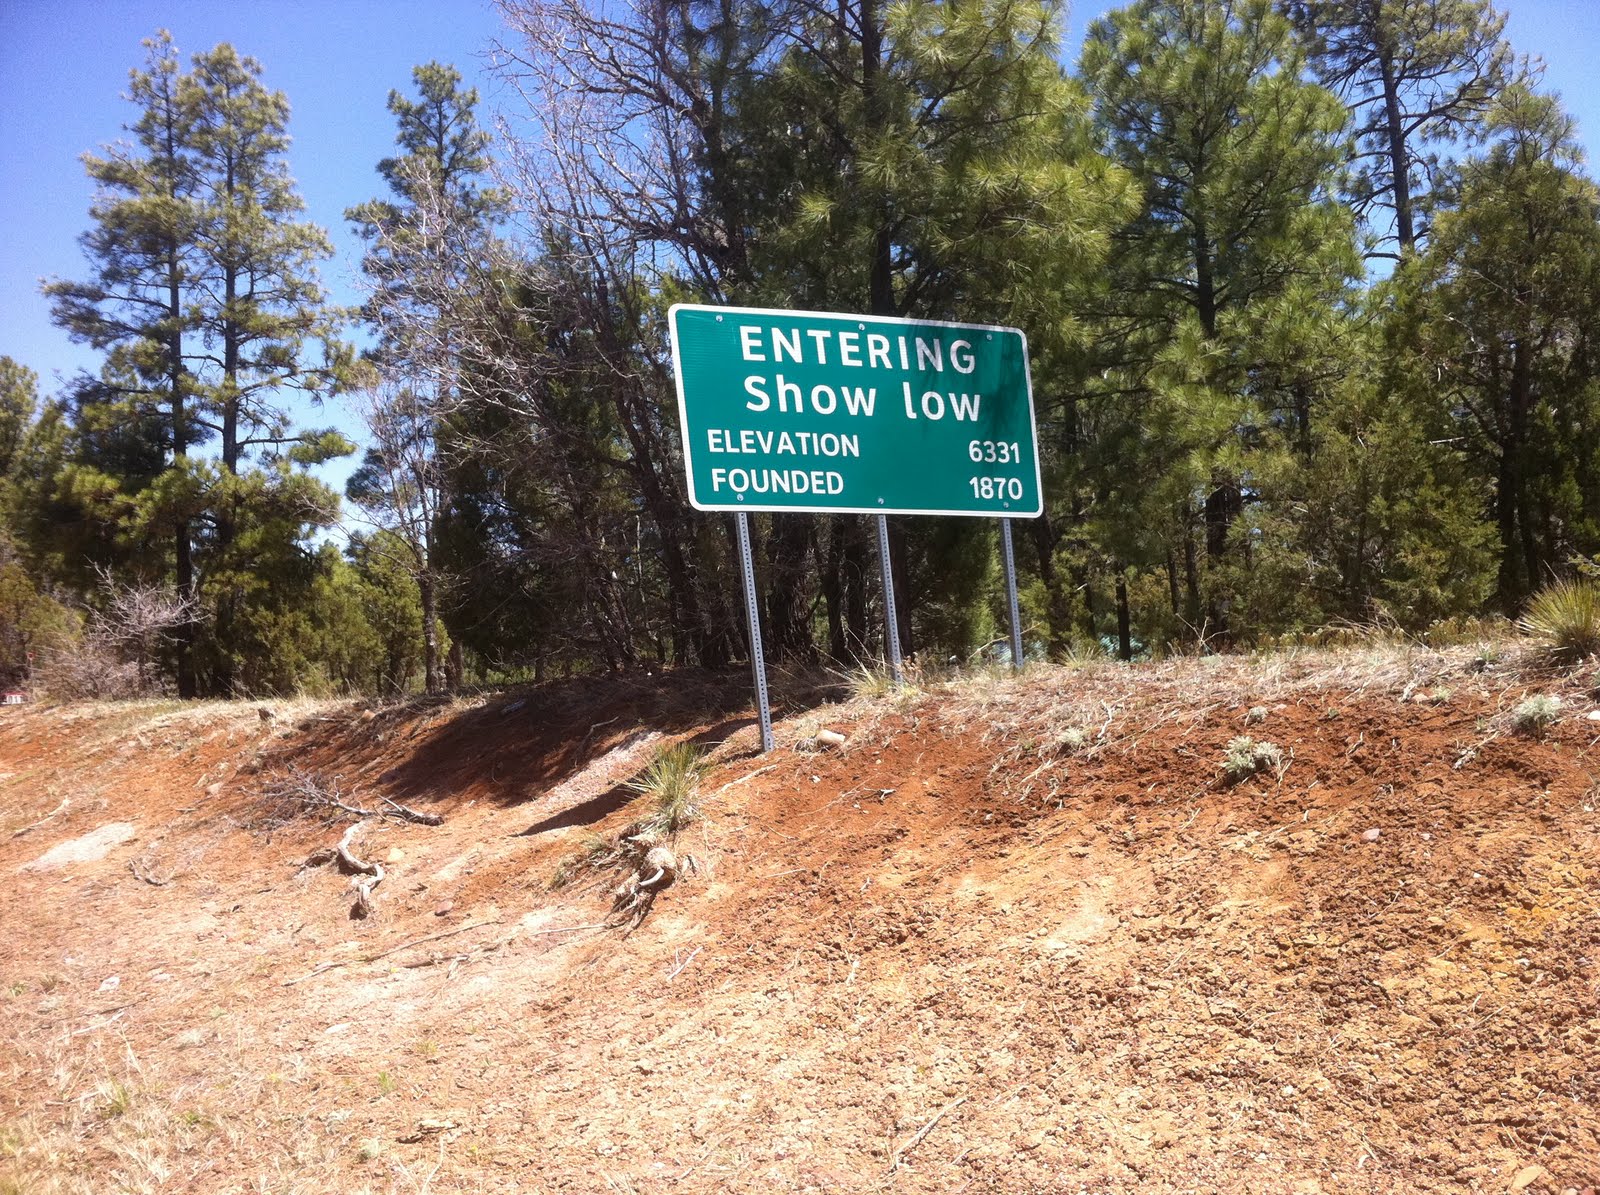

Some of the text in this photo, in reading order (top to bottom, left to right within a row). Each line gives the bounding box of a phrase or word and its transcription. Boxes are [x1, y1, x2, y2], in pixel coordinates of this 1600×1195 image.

[739, 325, 977, 375] ENTERING
[743, 373, 877, 416] Show
[707, 429, 1021, 465] ELEVATION 6331
[711, 468, 1024, 501] FOUNDED 1870
